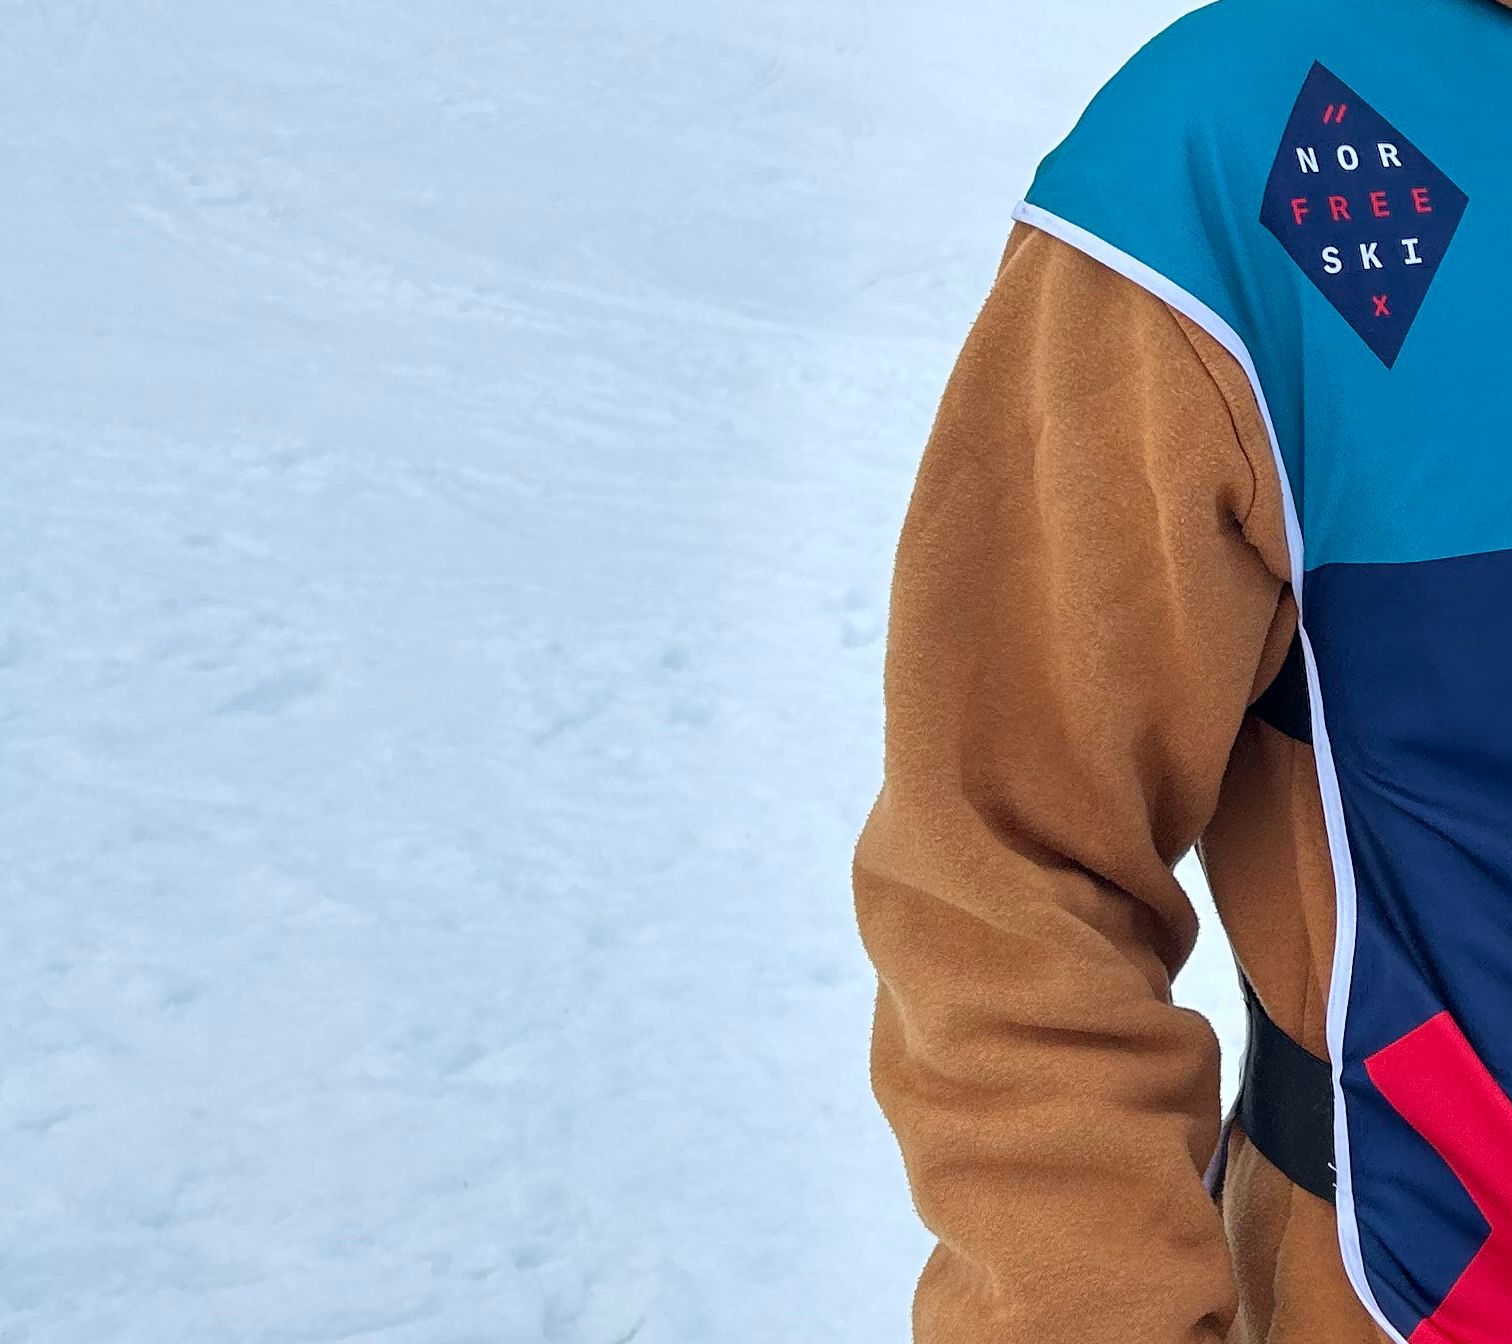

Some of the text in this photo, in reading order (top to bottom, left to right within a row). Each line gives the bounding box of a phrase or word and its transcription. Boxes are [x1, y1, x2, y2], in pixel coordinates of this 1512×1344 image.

[1296, 142, 1402, 174] NOR
[1291, 187, 1432, 225] FREE
[1321, 237, 1422, 274] SKI
